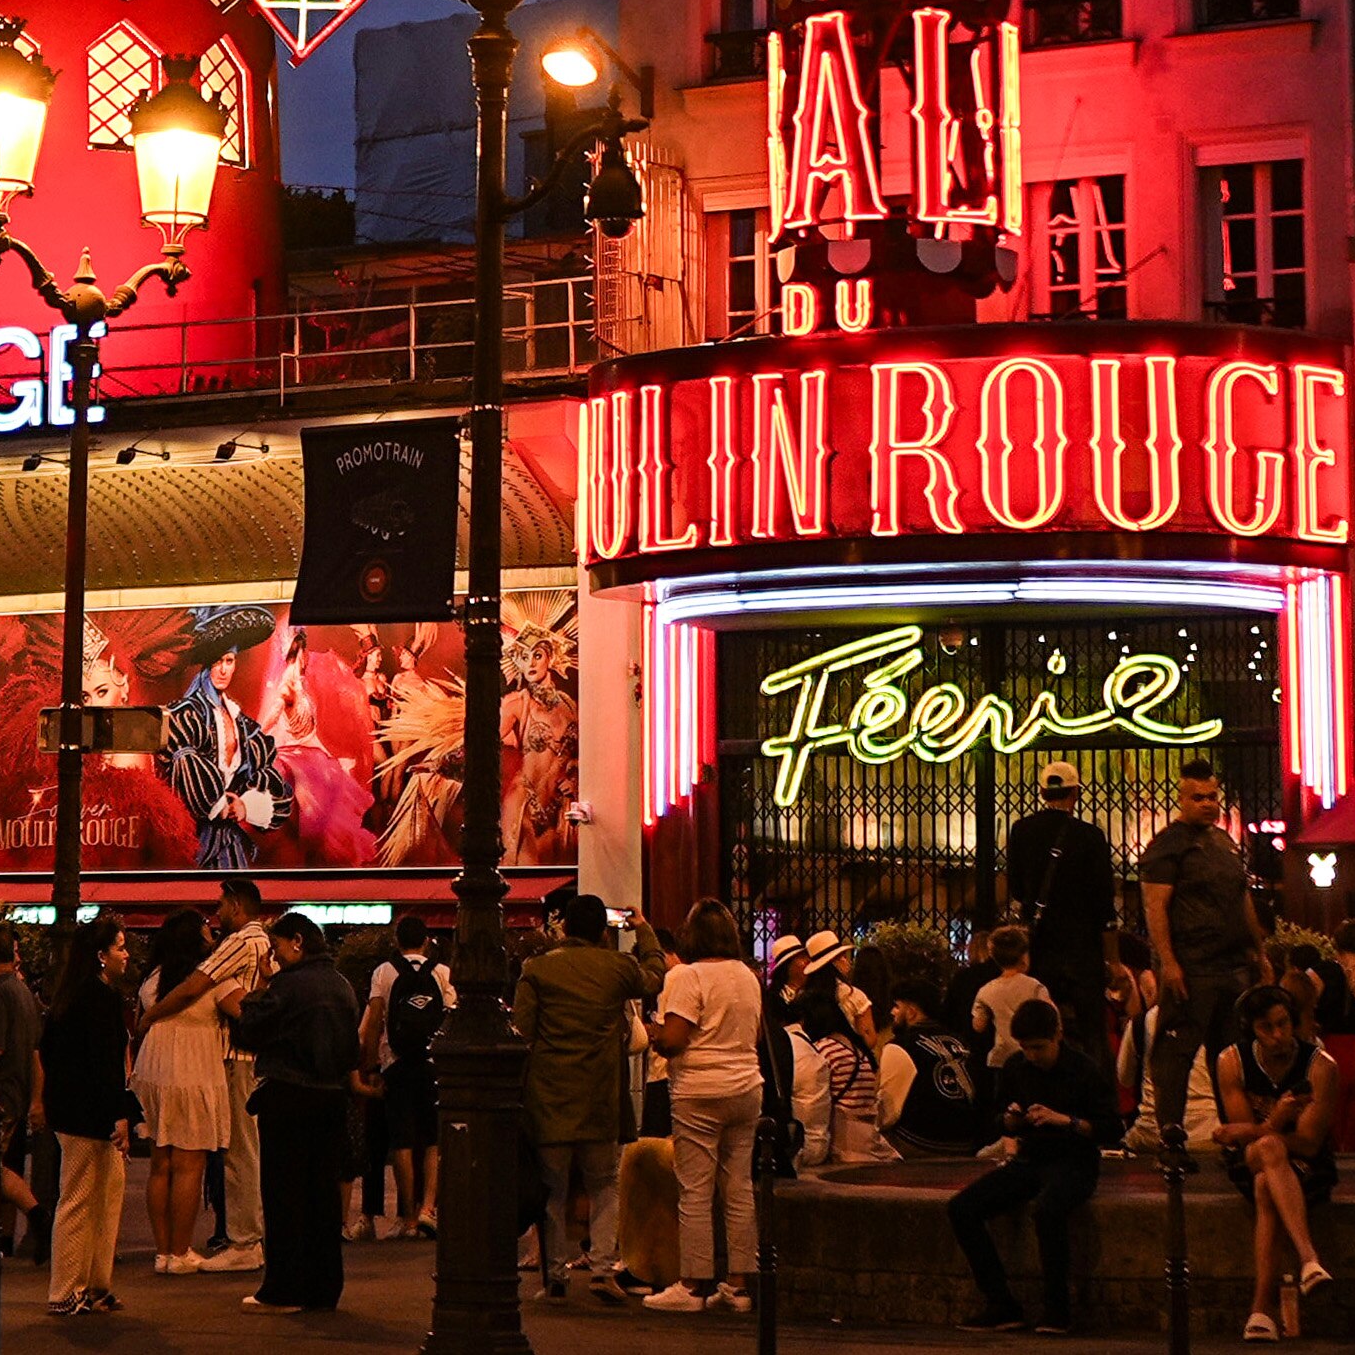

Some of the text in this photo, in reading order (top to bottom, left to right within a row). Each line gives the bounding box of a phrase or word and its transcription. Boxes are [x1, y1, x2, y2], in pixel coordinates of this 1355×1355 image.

[768, 7, 998, 243] AL
[781, 280, 870, 336] DU
[335, 441, 425, 476] PROMOTRAIN
[577, 355, 1349, 564] ULIN ROUGE
[760, 624, 1223, 808] Féerie
